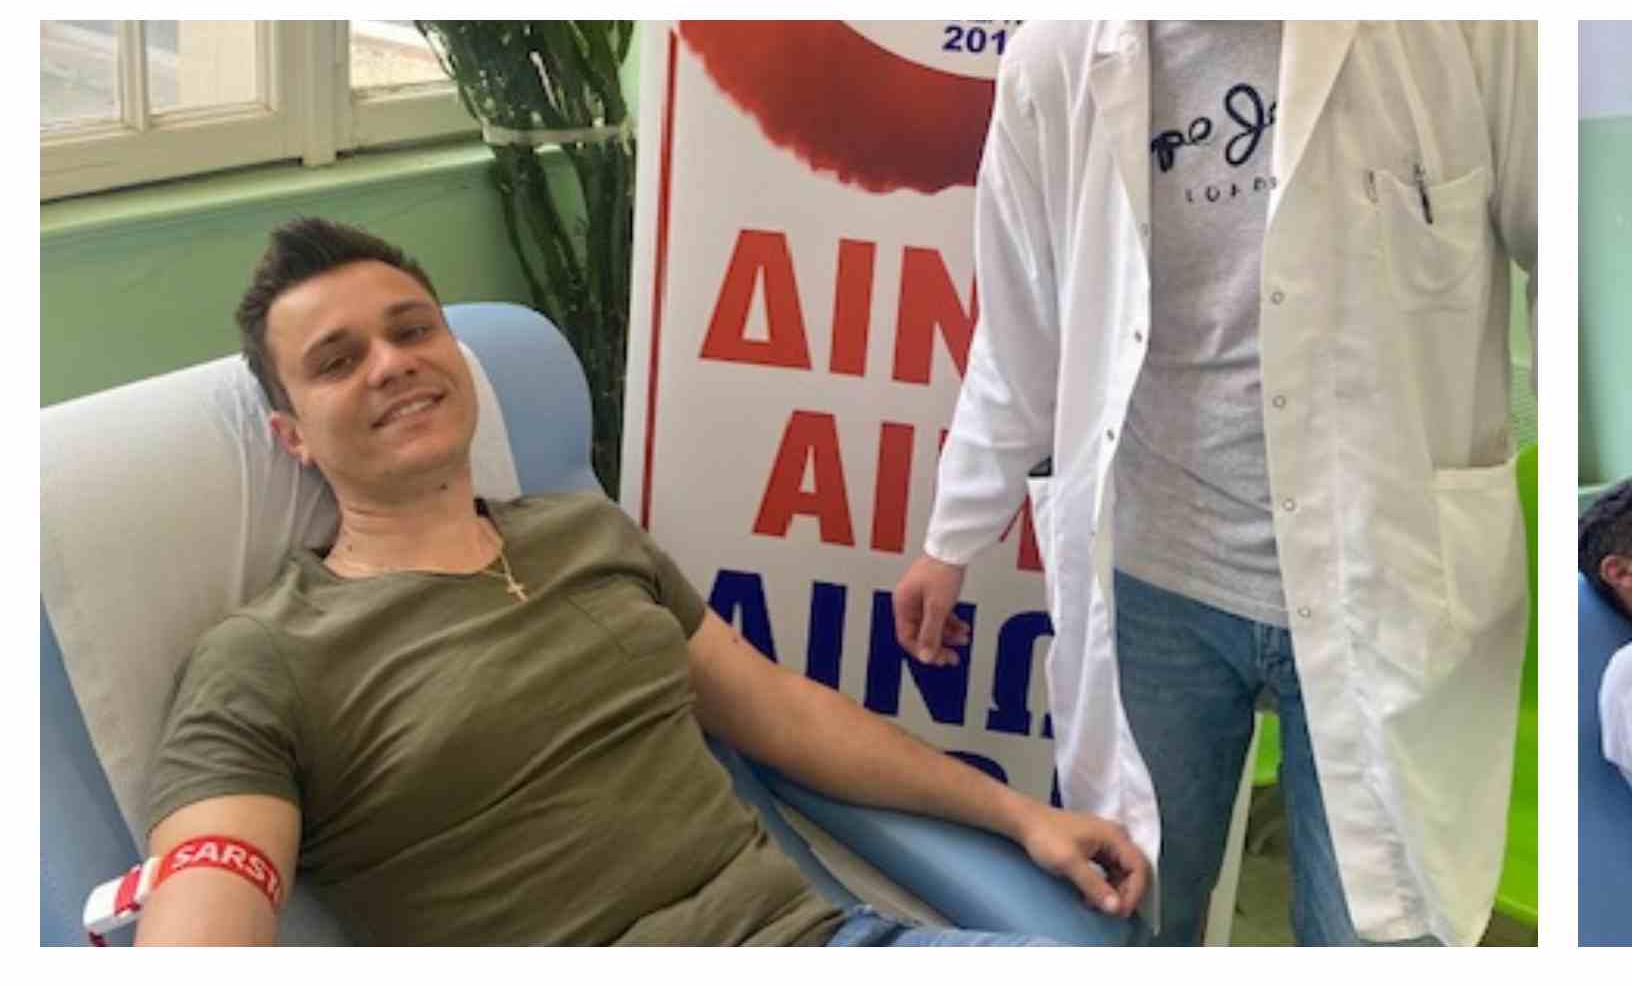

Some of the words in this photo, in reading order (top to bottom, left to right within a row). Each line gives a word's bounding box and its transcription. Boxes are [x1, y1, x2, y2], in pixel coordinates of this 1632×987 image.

[942, 26, 1006, 55] 201
[699, 229, 980, 386] ΔΙΝ
[172, 841, 281, 899] SARST
